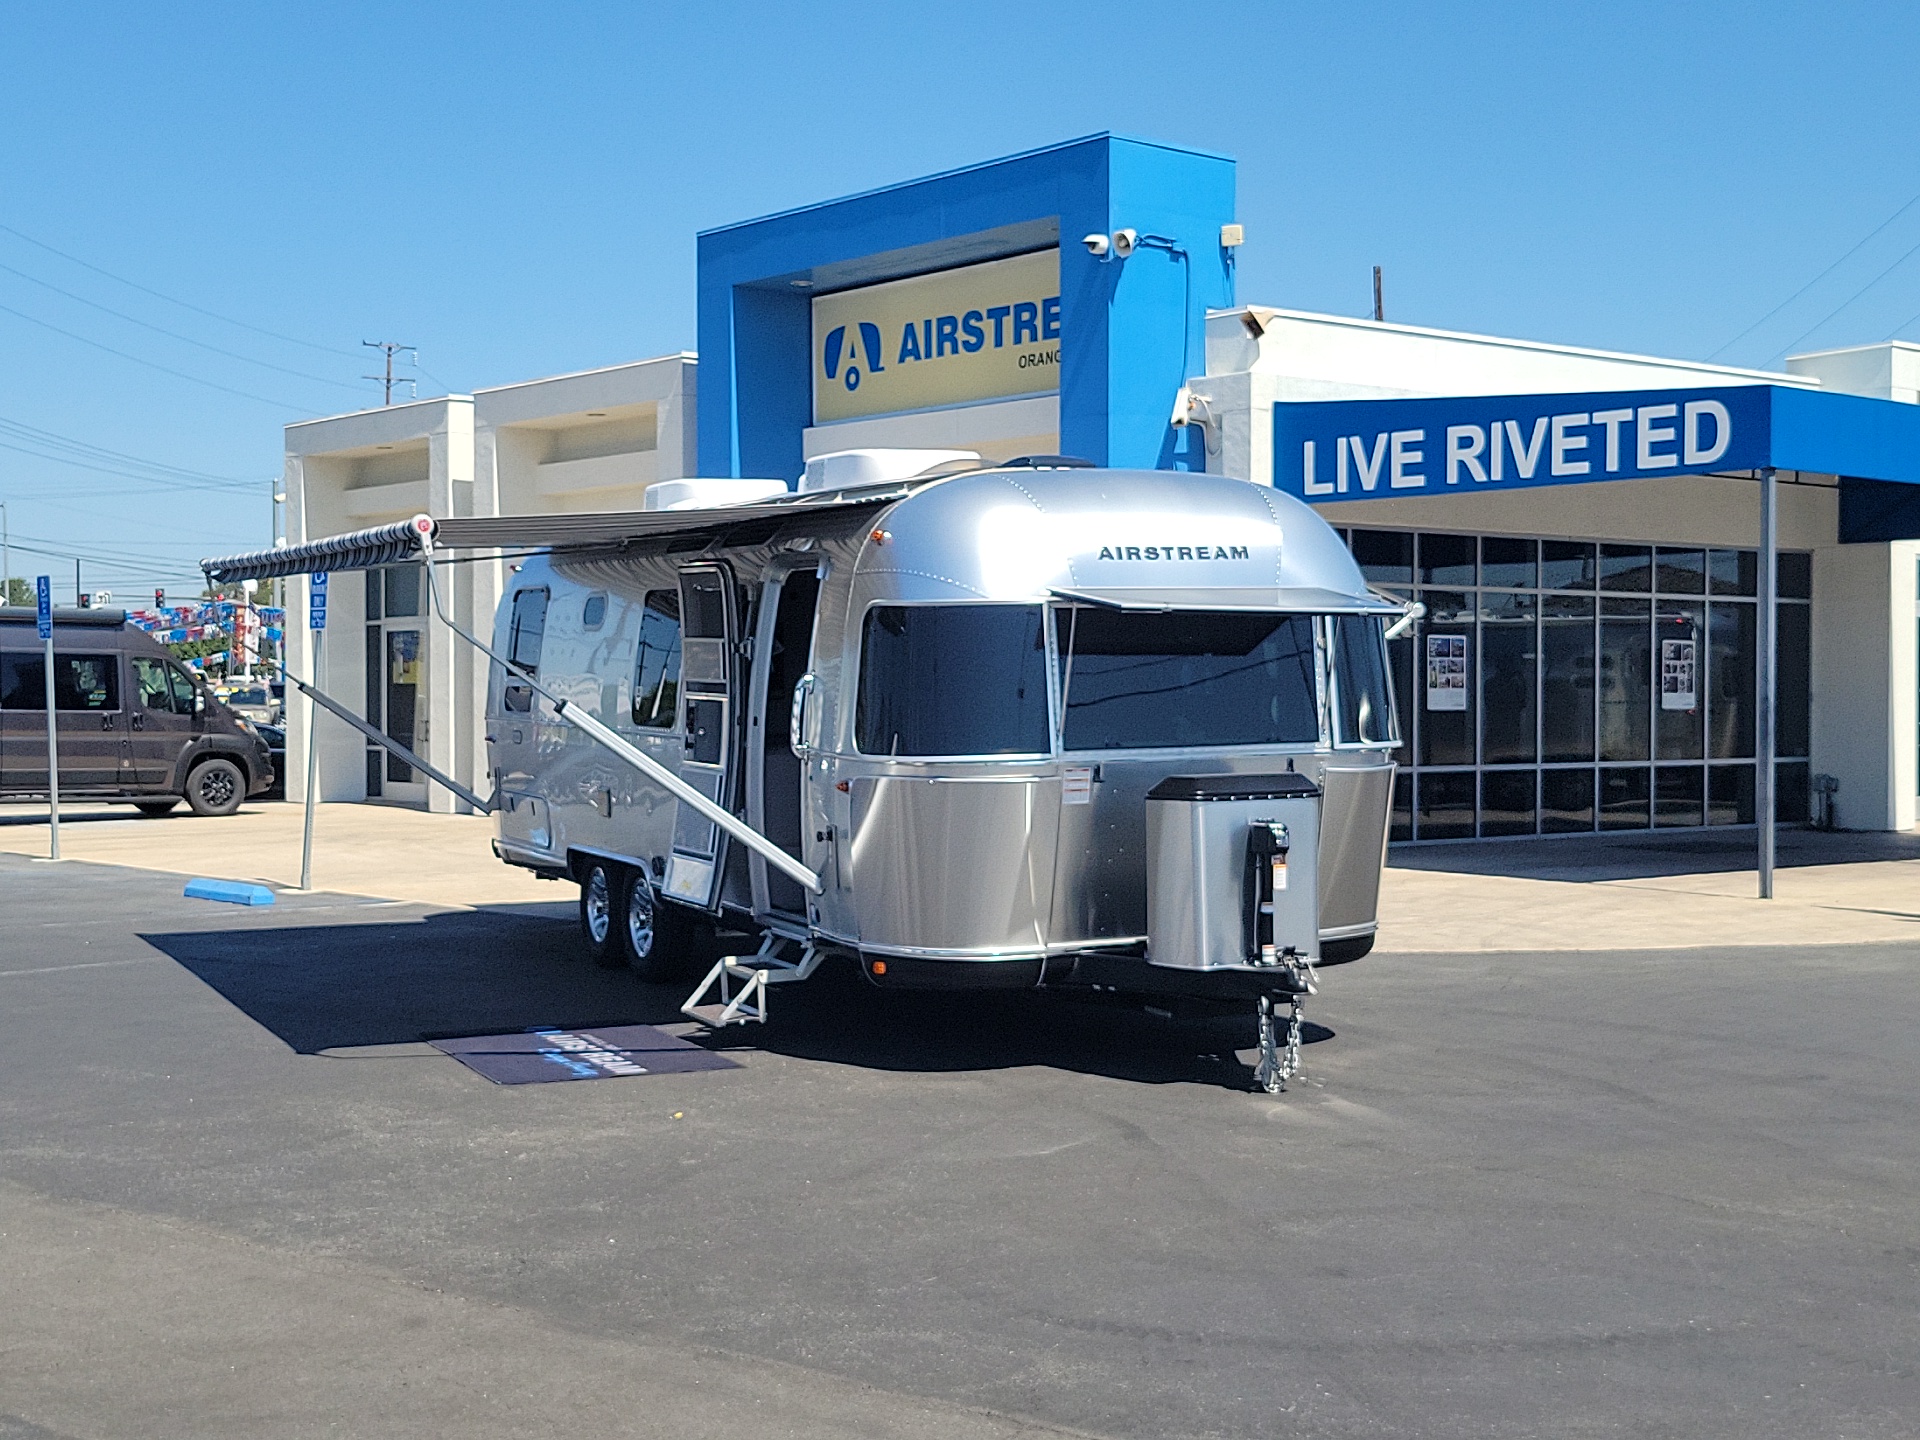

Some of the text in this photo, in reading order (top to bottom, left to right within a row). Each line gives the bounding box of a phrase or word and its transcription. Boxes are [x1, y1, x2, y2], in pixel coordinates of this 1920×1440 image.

[897, 296, 1061, 365] AIRSTRE
[1302, 399, 1732, 496] LIVE RIVETED
[1097, 546, 1250, 561] AIRSTREAM
